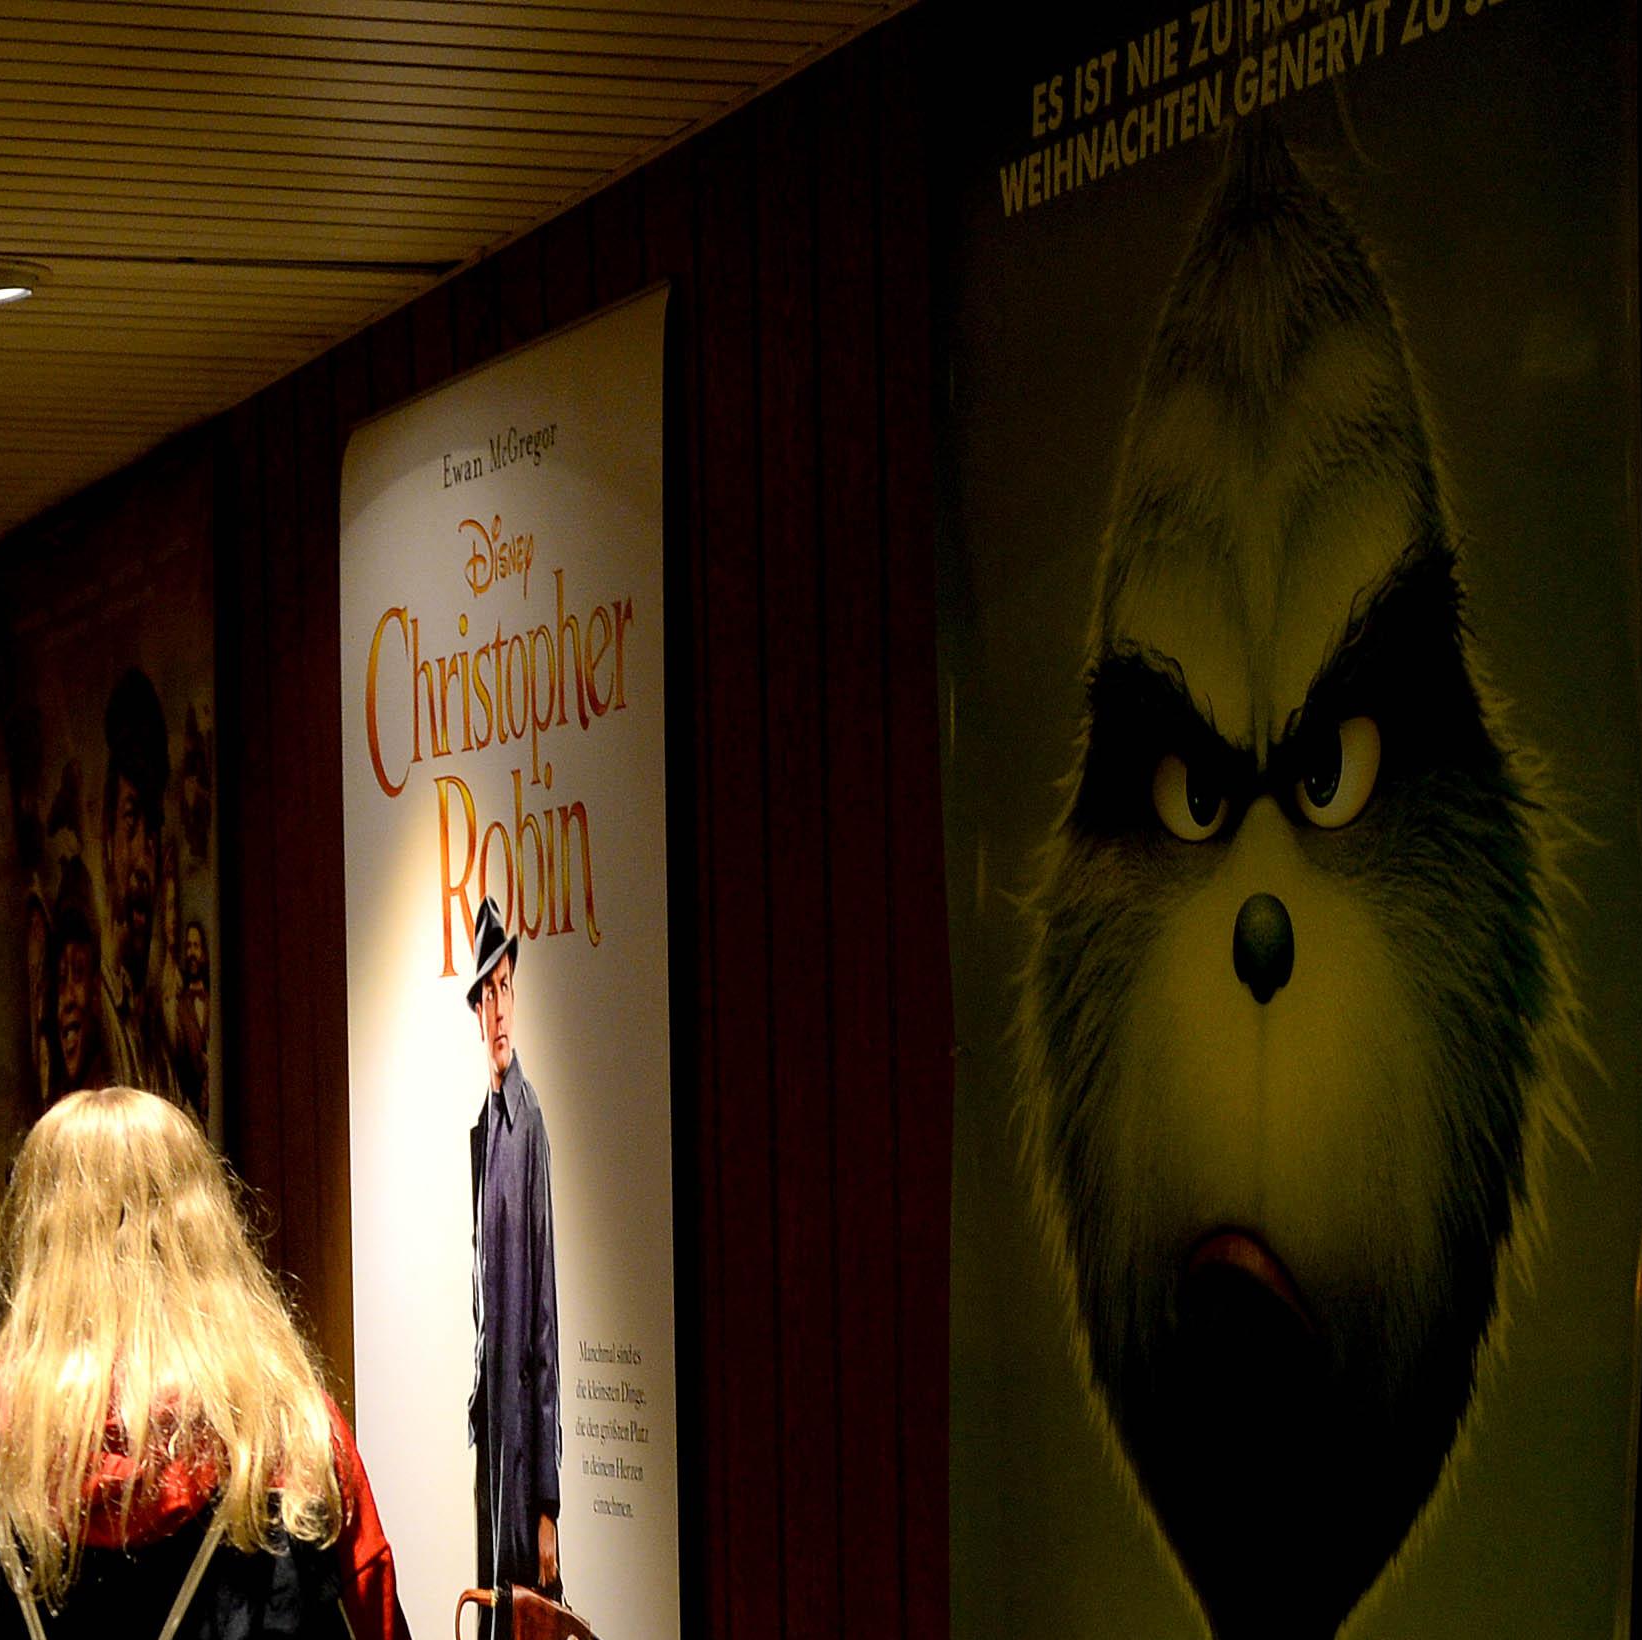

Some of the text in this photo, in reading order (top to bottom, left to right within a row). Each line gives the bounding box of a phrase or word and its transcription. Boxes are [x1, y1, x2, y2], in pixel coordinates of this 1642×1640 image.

[999, 70, 1224, 218] WEIHNACHTEN
[1233, 0, 1390, 117] GENERVT
[1031, 0, 1342, 138] ES IST NIE ZU FR
[443, 423, 557, 488] Ewan McGregor
[365, 569, 633, 799] Christopher
[433, 762, 601, 978] Robin
